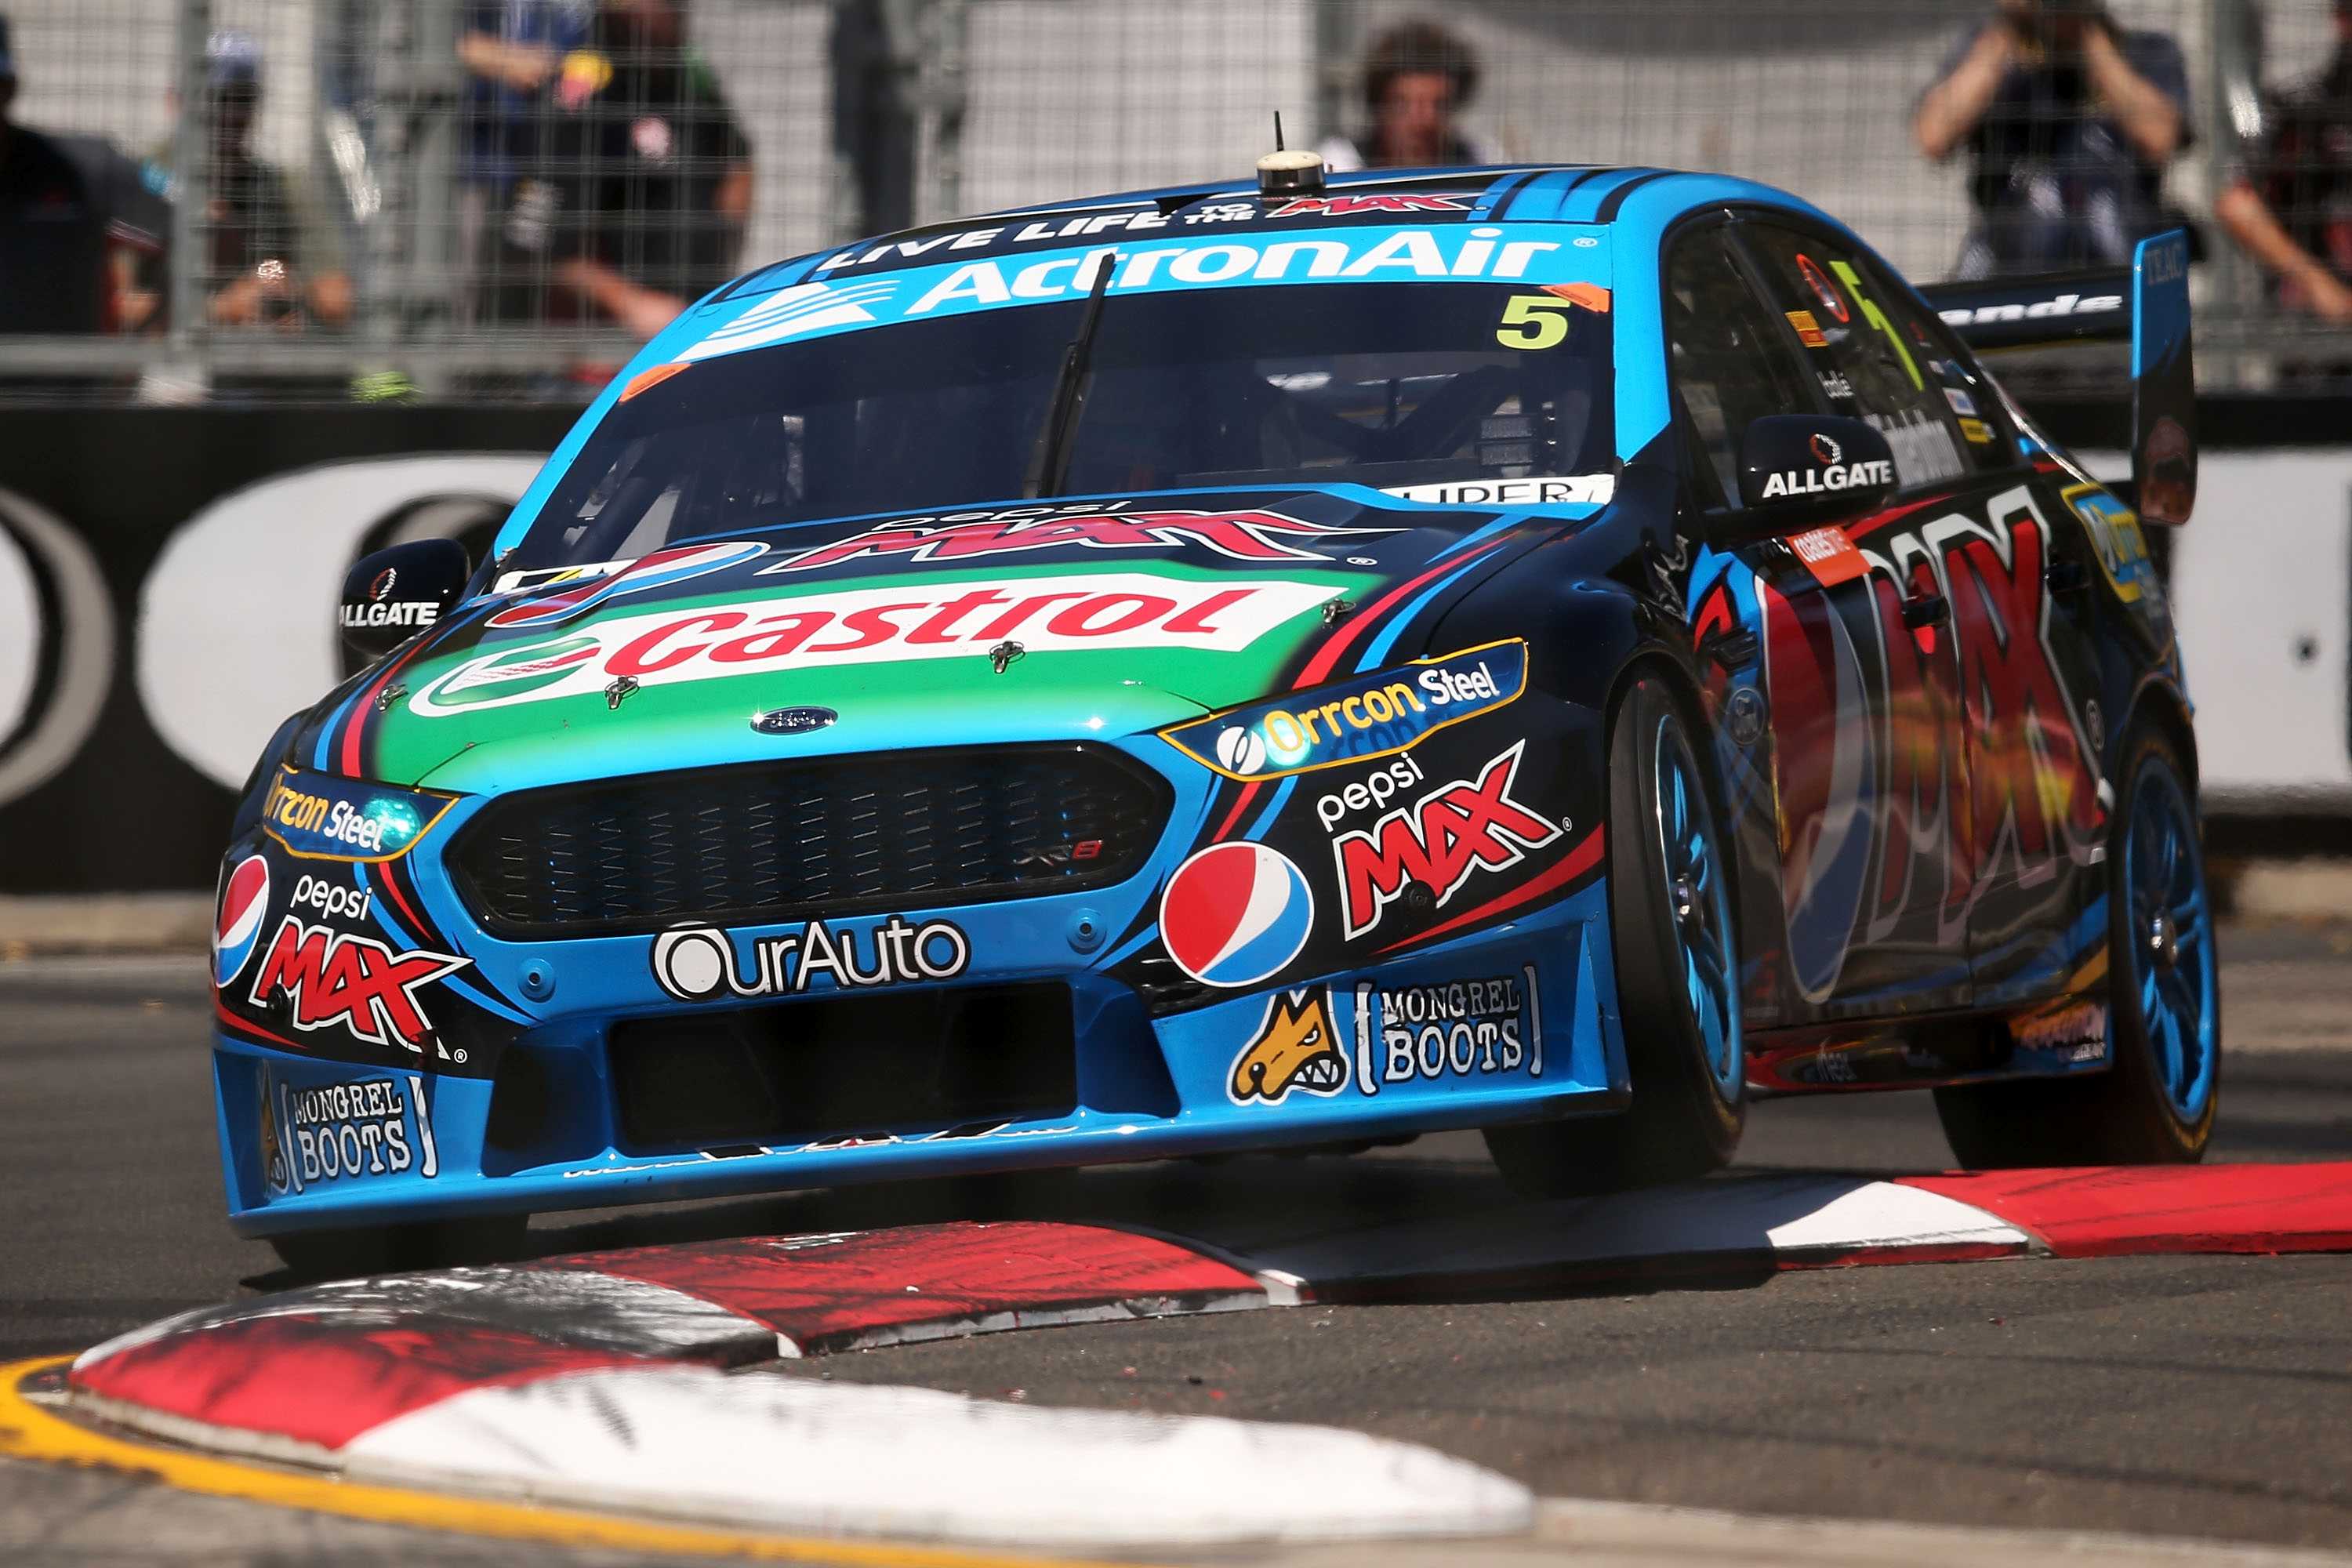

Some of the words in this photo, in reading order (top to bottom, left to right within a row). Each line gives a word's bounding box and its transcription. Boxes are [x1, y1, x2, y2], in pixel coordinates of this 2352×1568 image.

[1184, 210, 1256, 225] THE
[1200, 202, 1254, 214] TO
[1265, 193, 1484, 220] MAX
[816, 227, 1006, 272] LIVE
[1012, 211, 1178, 241] LIFE
[904, 227, 1561, 315] ActronAir
[1496, 296, 1570, 350] 5
[1762, 459, 1893, 499] ALLGATE
[753, 509, 1403, 576] MAX
[870, 500, 1131, 532] pepsi
[604, 588, 1264, 676] Castrol
[1264, 681, 1423, 752] Orrcon
[1417, 661, 1501, 706] Steel
[1316, 751, 1425, 833] pepsi
[323, 800, 386, 853] Steel
[1333, 738, 1564, 942] MAX
[290, 873, 373, 921] pepsi
[249, 914, 474, 1060] MAX
[653, 919, 968, 1000] OurAuto
[1381, 978, 1522, 1027] MONGREL
[1384, 1018, 1524, 1082] BOOTS
[294, 1080, 405, 1123] MONGREL
[297, 1119, 412, 1182] BOOTS
